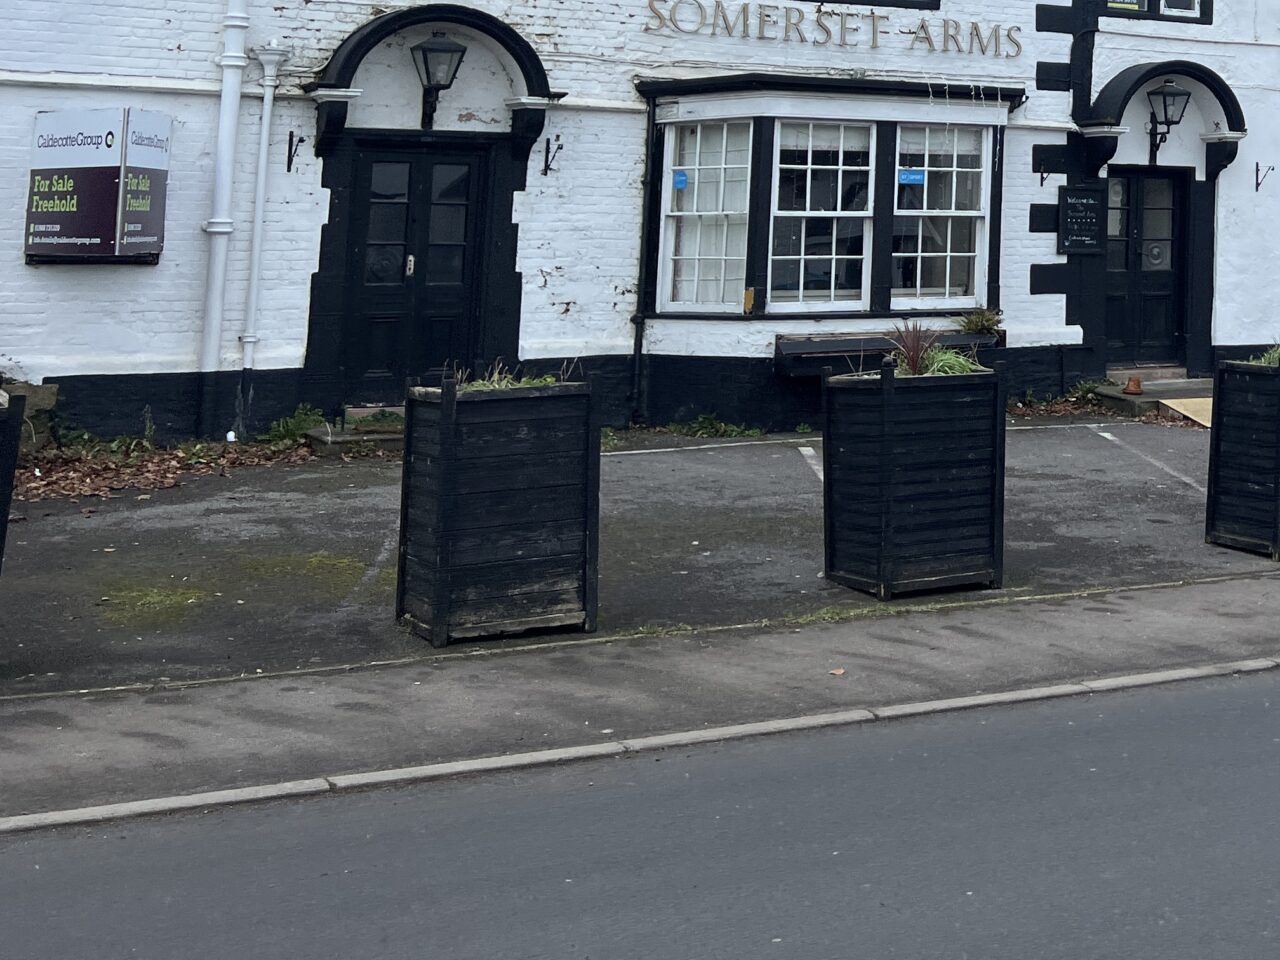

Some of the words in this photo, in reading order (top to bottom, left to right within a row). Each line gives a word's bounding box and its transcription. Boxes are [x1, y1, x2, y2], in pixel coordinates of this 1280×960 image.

[910, 17, 1023, 58] ARMS
[37, 132, 103, 149] CaldecotteGroup
[33, 176, 50, 192] For
[52, 174, 74, 192] Sale
[127, 173, 138, 190] For
[138, 174, 151, 191] Sale
[31, 195, 78, 212] Freehold
[126, 194, 151, 211] Freehold
